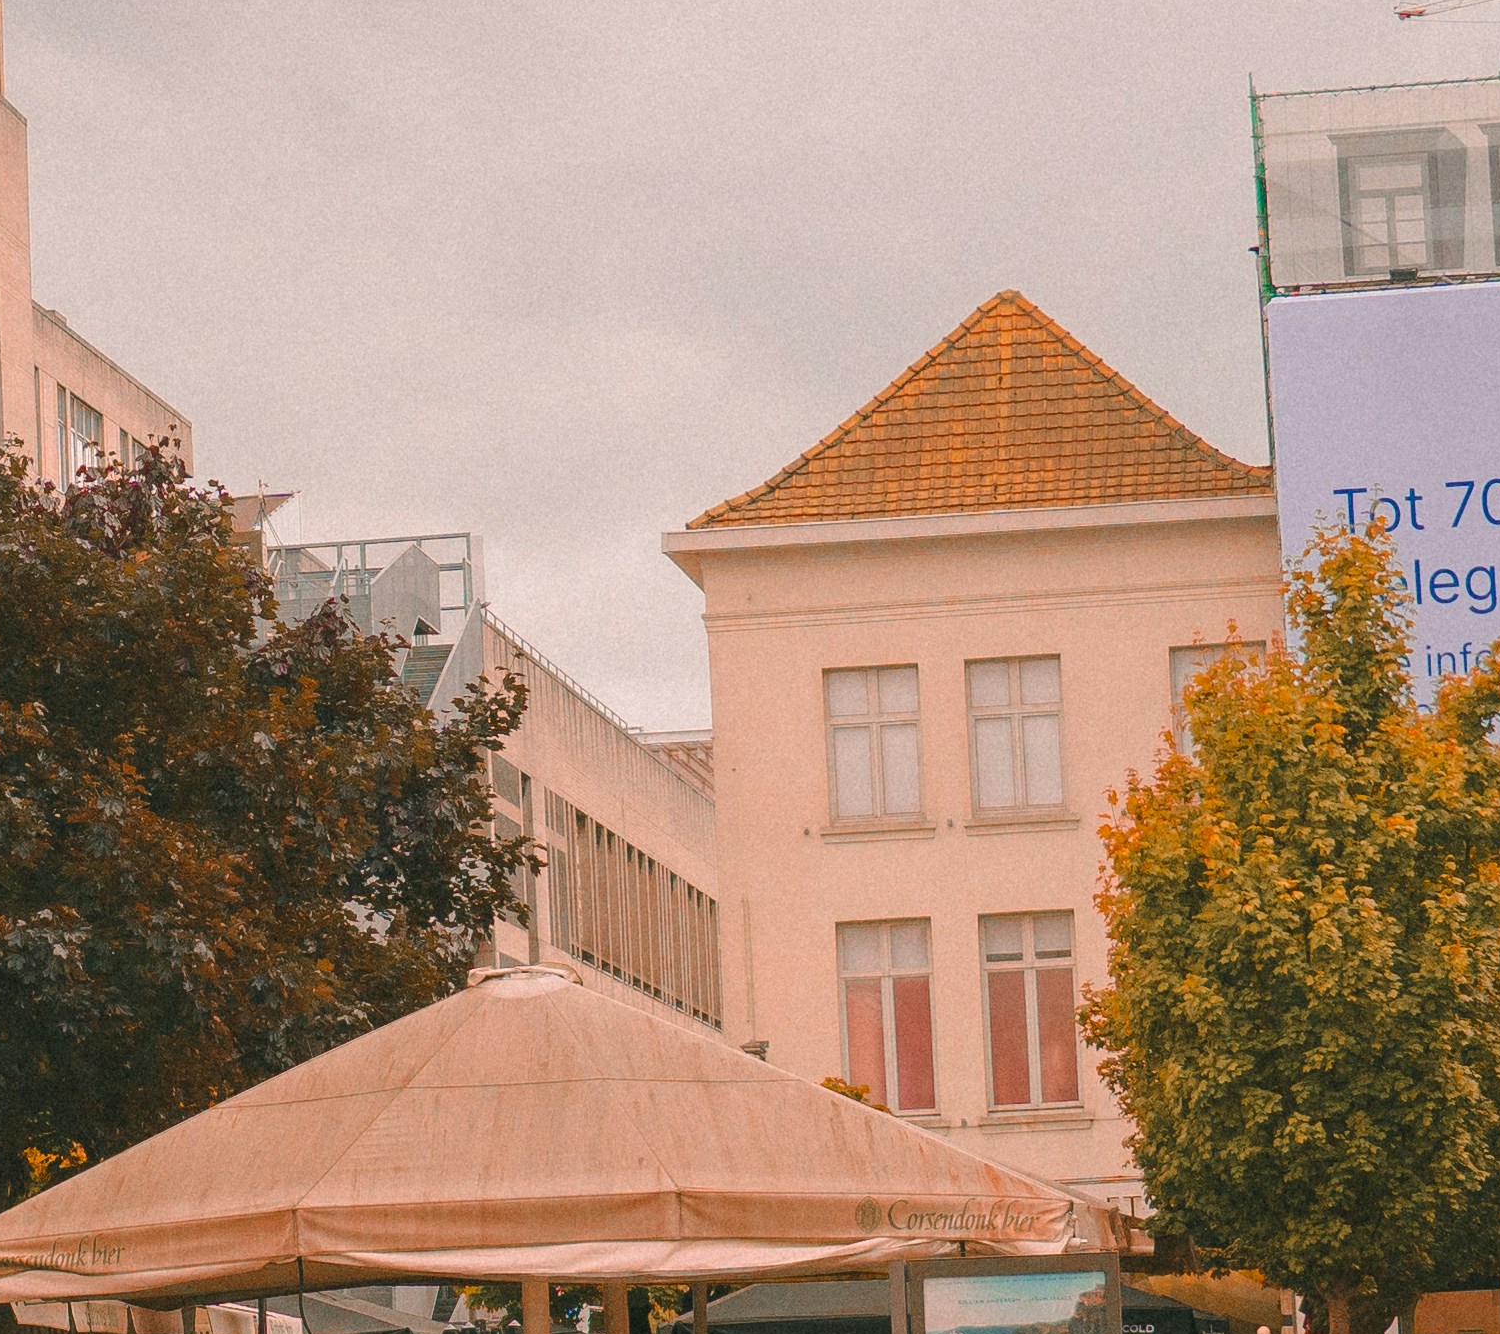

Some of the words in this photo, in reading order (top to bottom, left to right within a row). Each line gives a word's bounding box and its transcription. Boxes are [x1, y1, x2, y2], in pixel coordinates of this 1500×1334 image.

[1333, 483, 1425, 535] Tot
[887, 1198, 1003, 1232] Corsendonk
[1001, 1199, 1040, 1232] bier
[91, 1233, 125, 1266] bier
[1122, 1324, 1155, 1334] COLD
